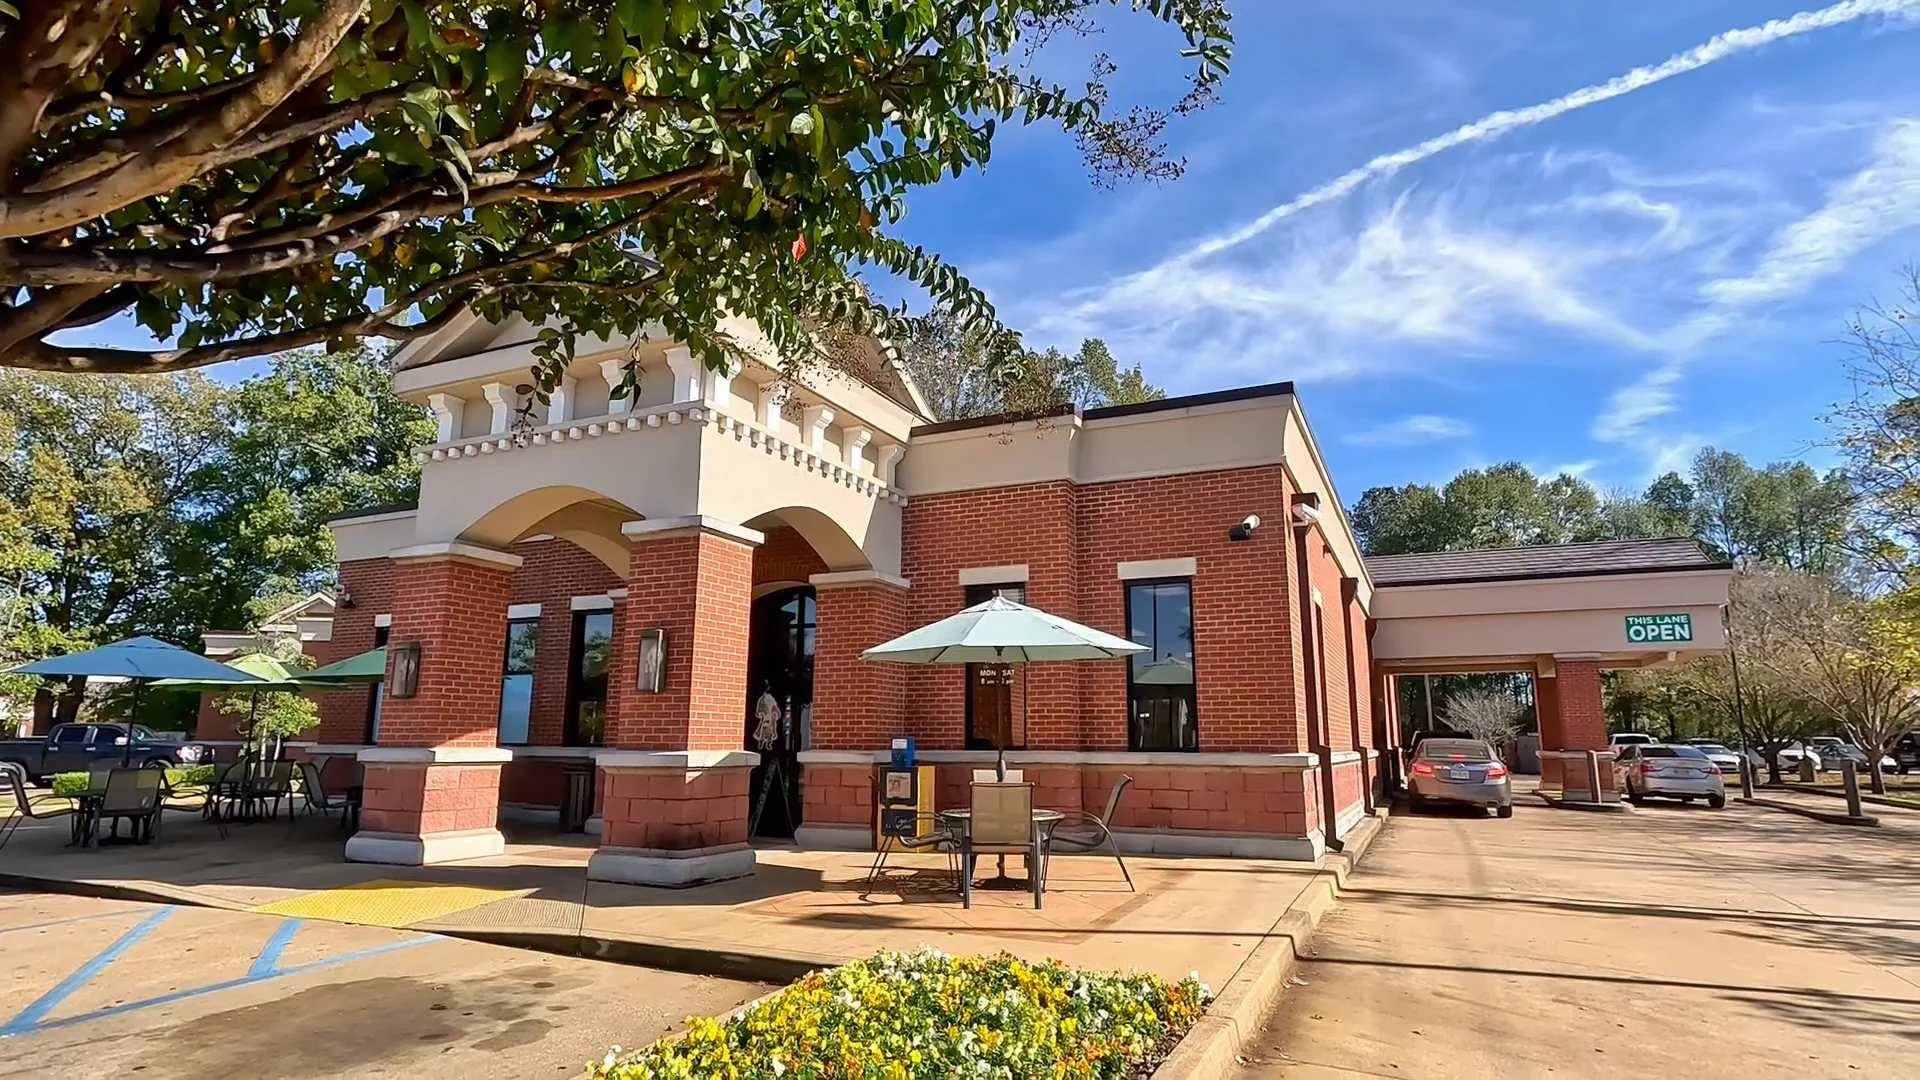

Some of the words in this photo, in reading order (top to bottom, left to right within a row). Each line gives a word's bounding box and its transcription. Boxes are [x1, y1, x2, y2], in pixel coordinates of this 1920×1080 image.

[1627, 617, 1653, 625] THIS
[1656, 615, 1688, 623] LANE
[1629, 624, 1690, 641] OPEN
